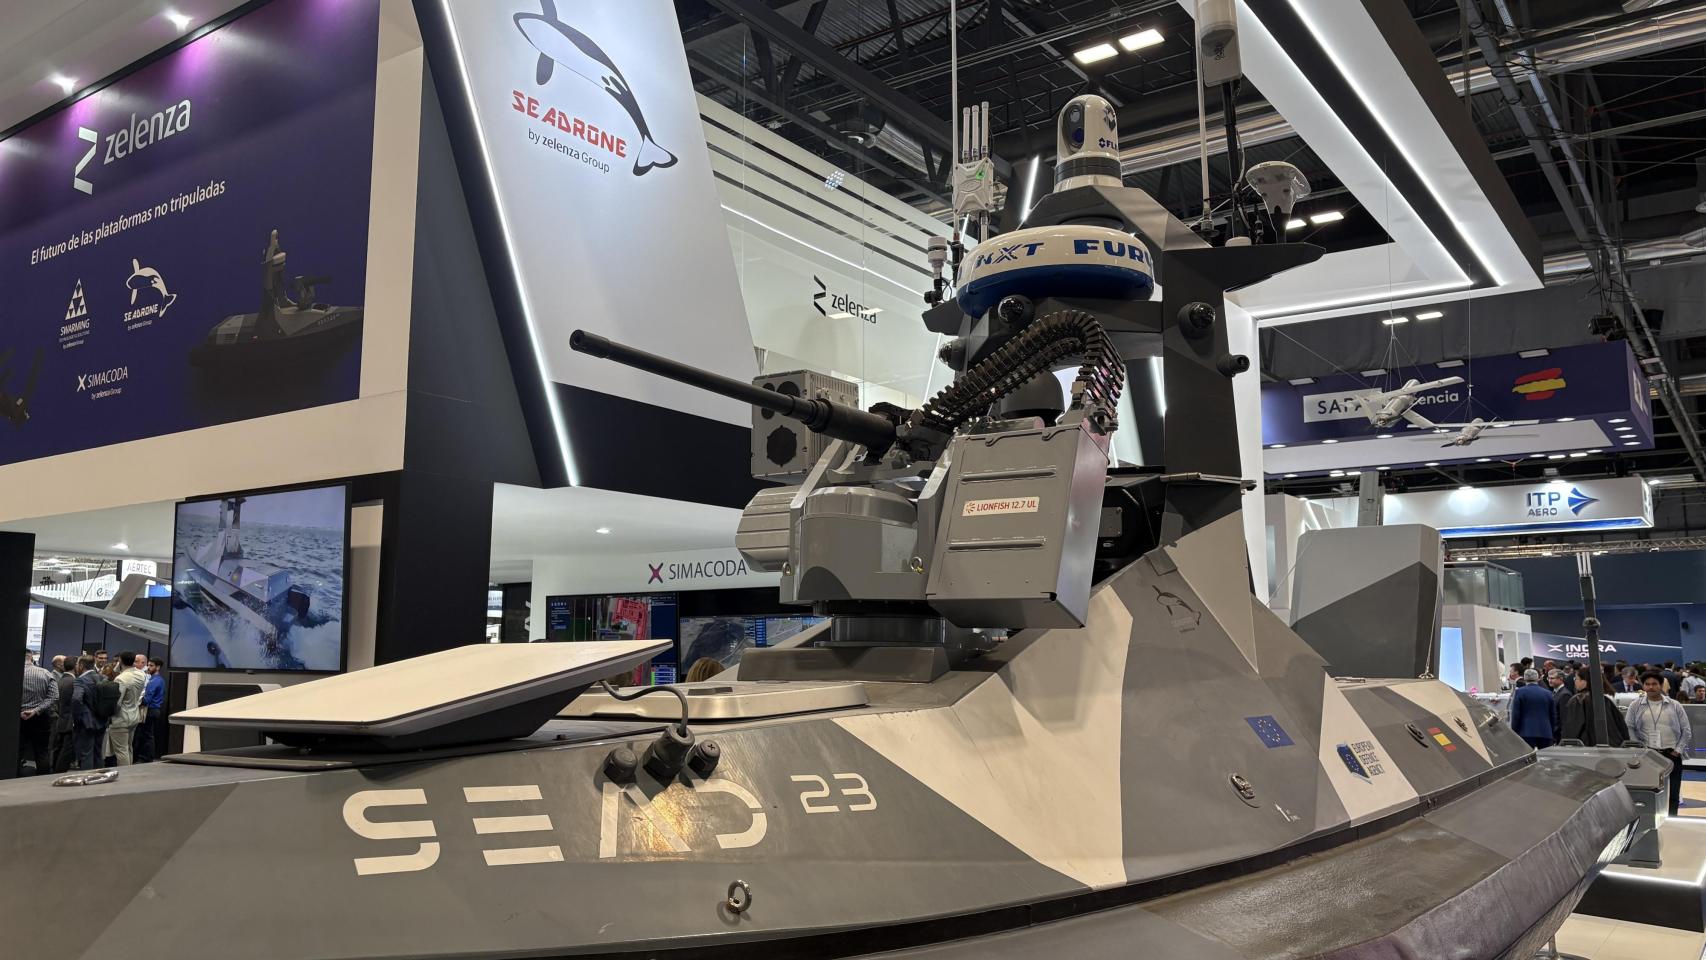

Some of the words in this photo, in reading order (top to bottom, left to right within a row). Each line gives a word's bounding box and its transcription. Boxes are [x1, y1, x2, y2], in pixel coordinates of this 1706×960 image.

[103, 99, 191, 165] zelenza
[512, 90, 627, 159] SEADRONE
[528, 128, 541, 146] by
[542, 135, 580, 160] zelenza
[581, 151, 610, 174] Group
[31, 248, 39, 265] El
[40, 244, 67, 262] futuro
[68, 234, 79, 251] de
[81, 230, 94, 247] las
[95, 208, 152, 244] plataformas
[154, 202, 168, 219] no
[170, 180, 226, 212] tripuladas
[976, 242, 1045, 268] NXT
[123, 303, 159, 322] SEADRONE
[60, 318, 90, 336] SWARMING
[87, 366, 128, 388] SIMACODA
[976, 502, 1009, 512] LIONFISH
[1011, 501, 1025, 509] 12.7
[1027, 499, 1036, 508] UL
[1527, 491, 1561, 507] ITP
[1528, 507, 1558, 517] AERO
[668, 559, 747, 580] SIMACODA
[790, 772, 877, 814] 23
